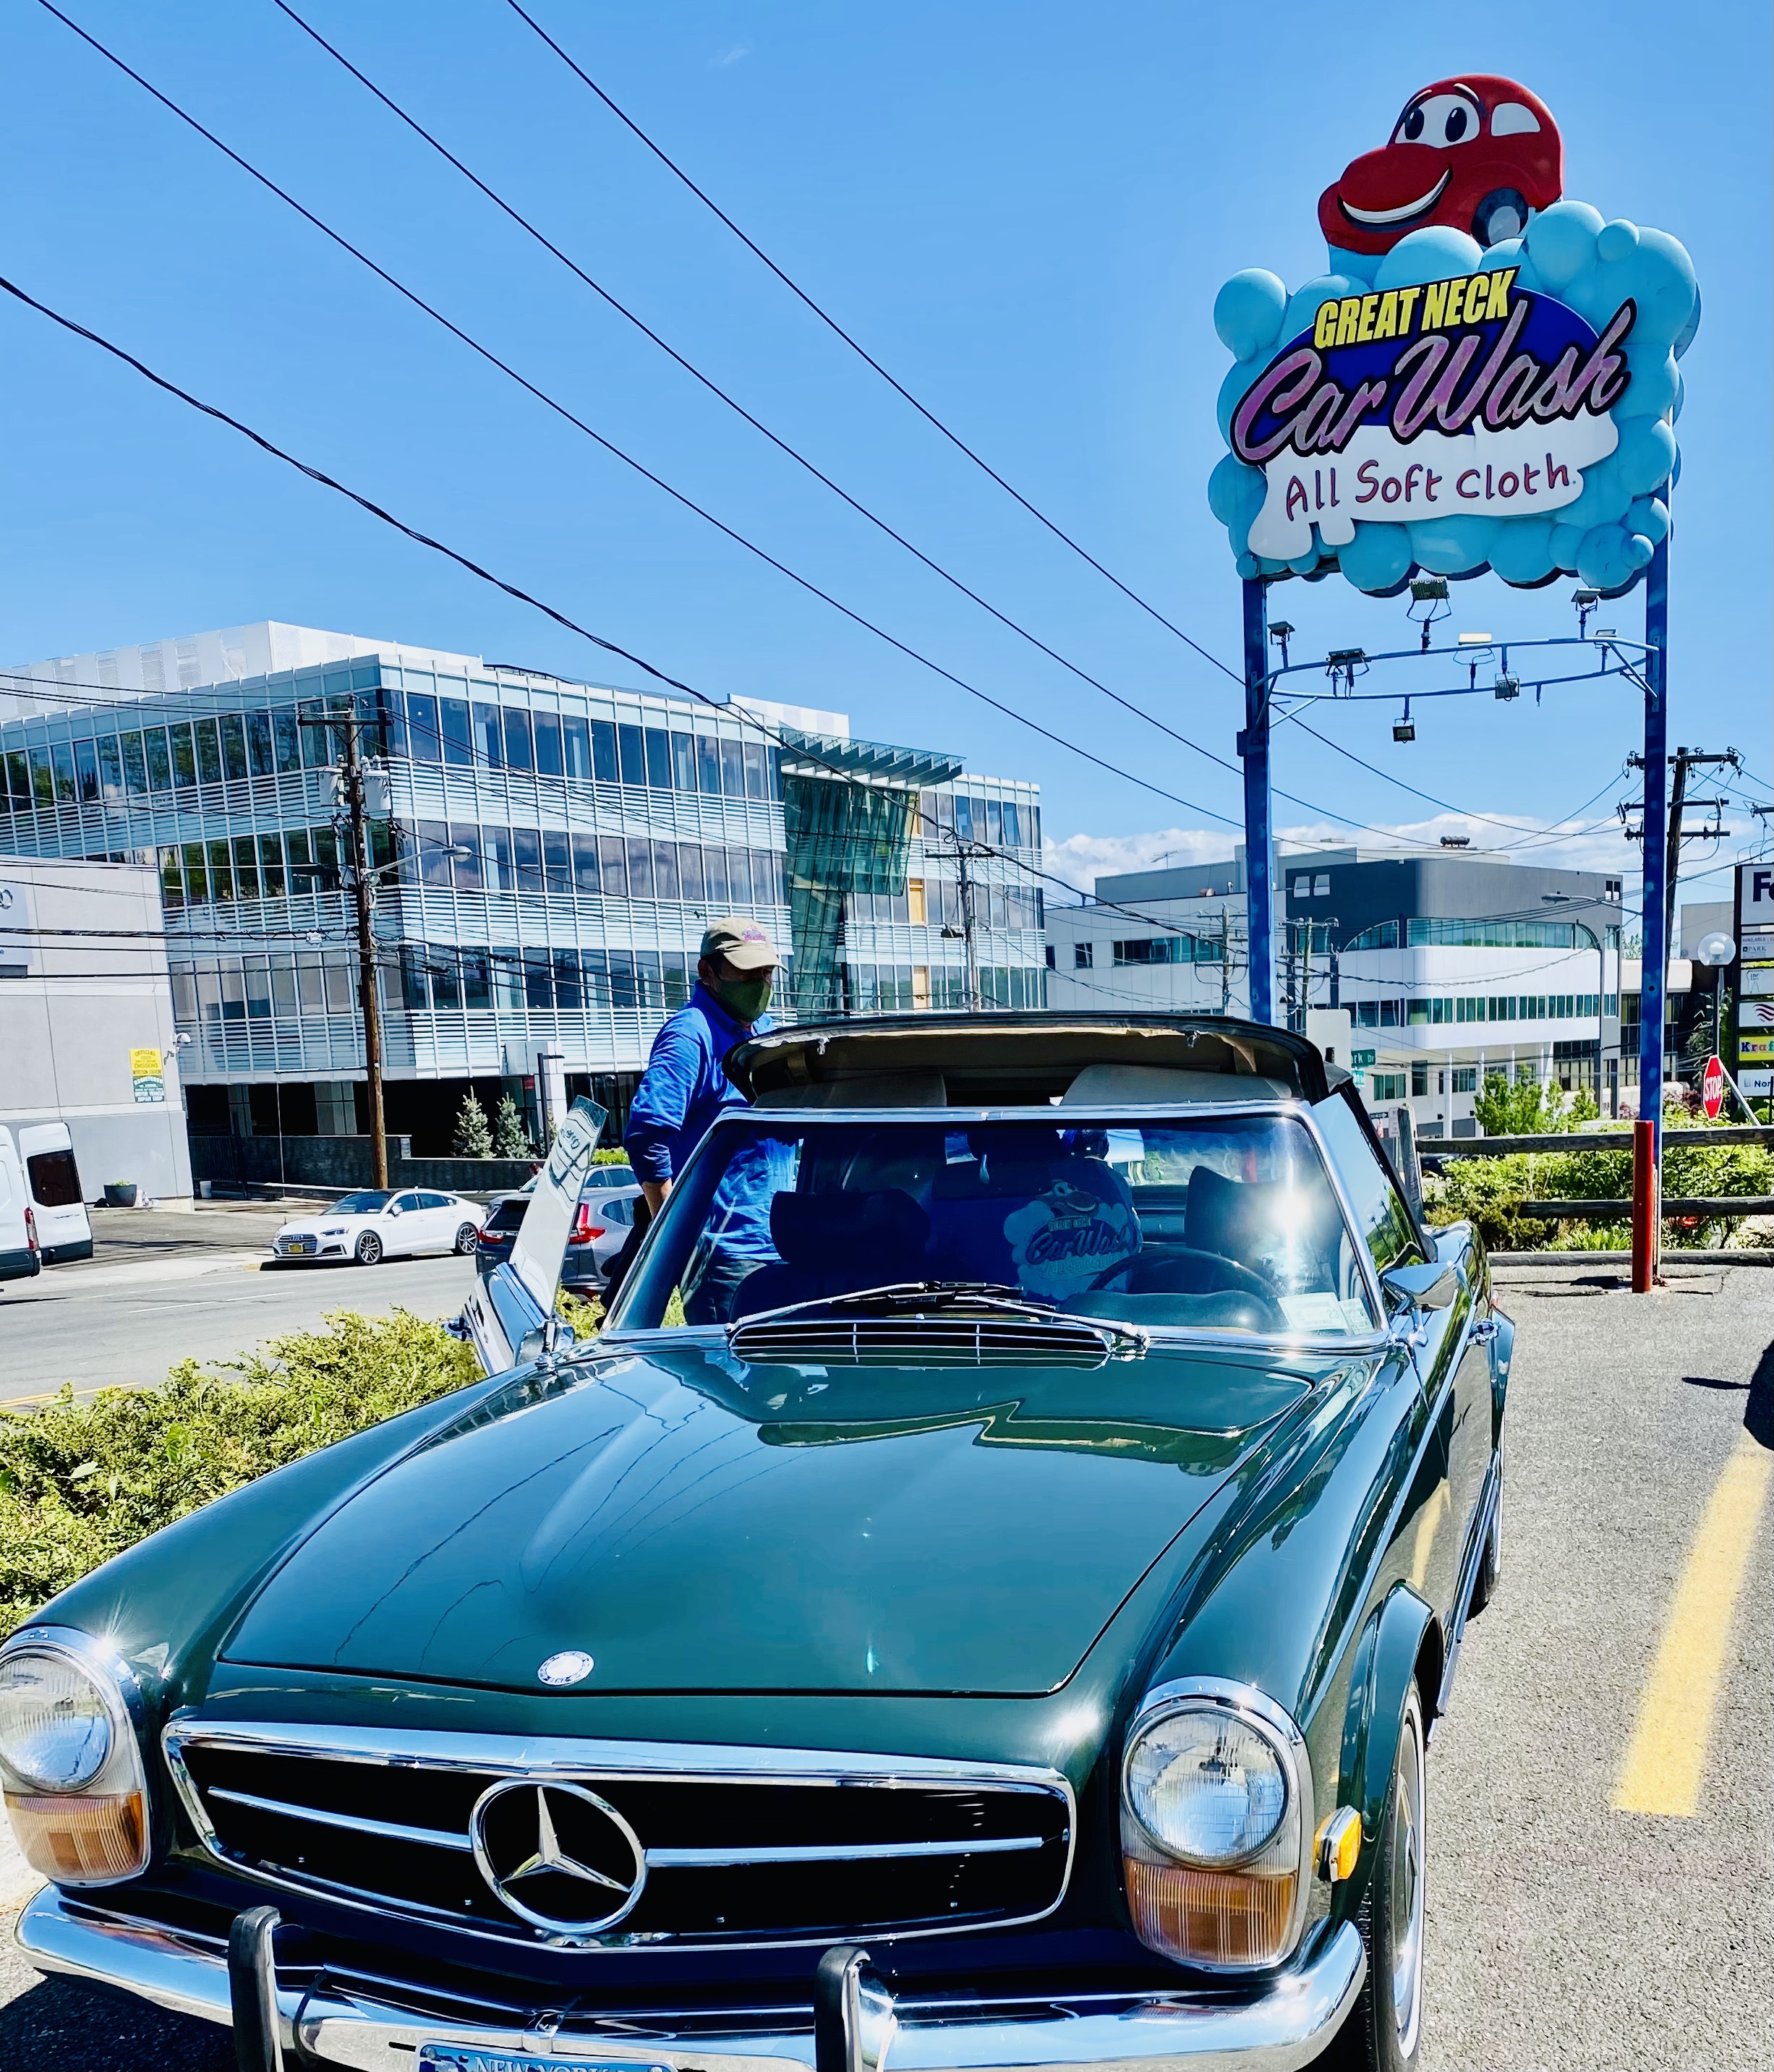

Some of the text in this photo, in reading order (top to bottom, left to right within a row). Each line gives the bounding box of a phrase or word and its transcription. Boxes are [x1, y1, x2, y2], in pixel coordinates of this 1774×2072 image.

[1314, 269, 1516, 349] GREAT NECK
[1234, 297, 1633, 461] Car Wash
[1285, 467, 1341, 521] All
[1355, 459, 1443, 503] Soft
[1753, 871, 1774, 903] F
[1352, 1053, 1375, 1064] rk Dr
[1705, 1075, 1722, 1101] STOP
[1025, 1232, 1075, 1265] Car
